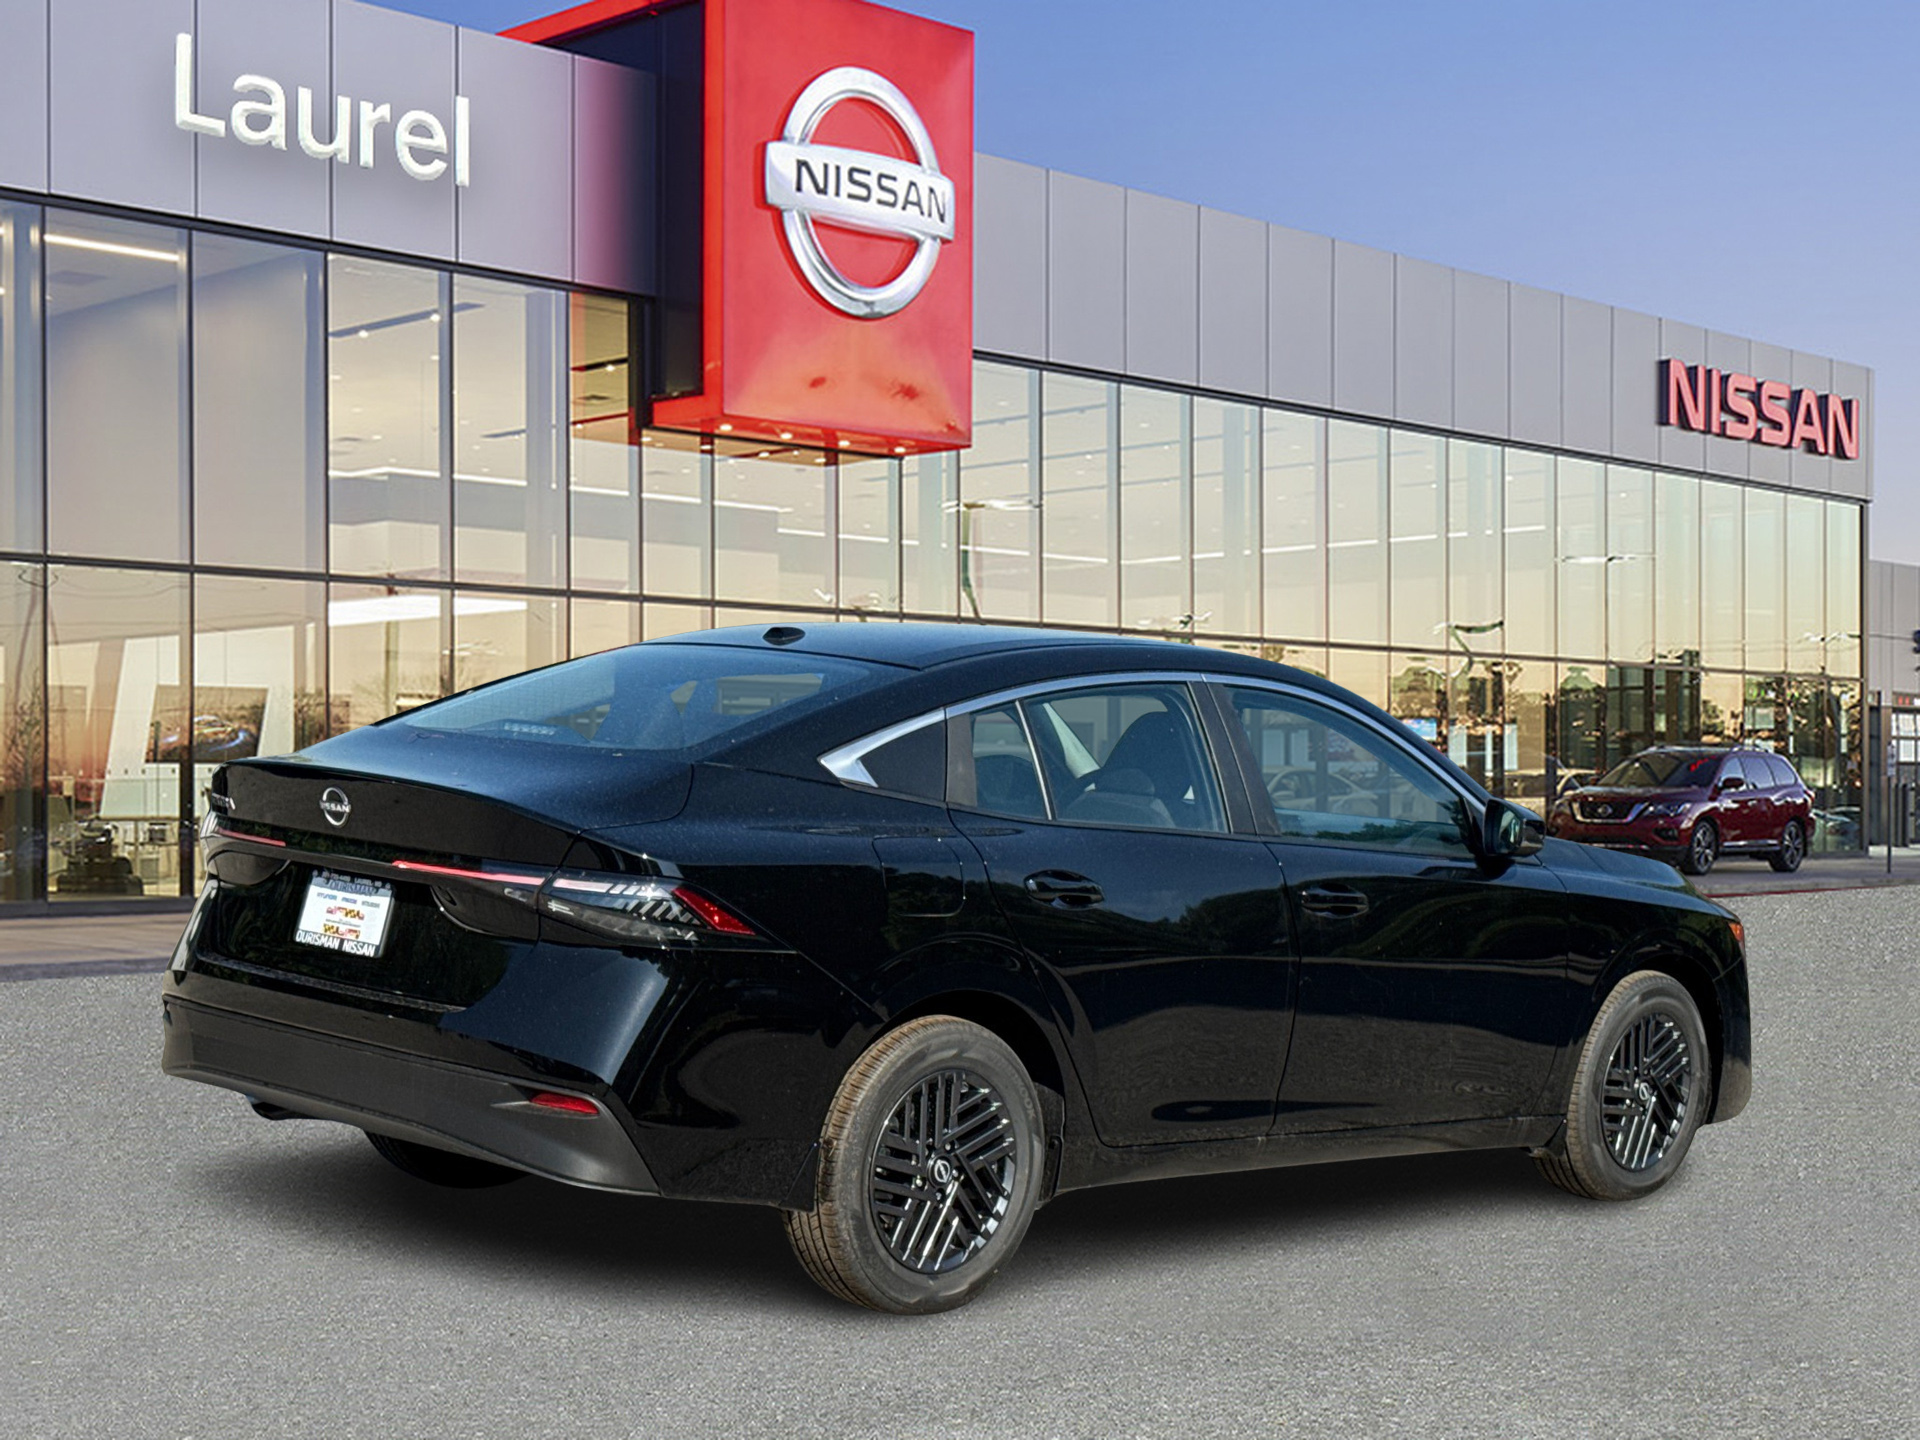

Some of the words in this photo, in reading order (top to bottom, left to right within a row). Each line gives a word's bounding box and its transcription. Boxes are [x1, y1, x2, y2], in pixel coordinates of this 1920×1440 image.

[175, 33, 470, 187] Laurel
[795, 158, 946, 224] NISSAN
[1656, 357, 1860, 460] NISSAN
[296, 929, 340, 950] OURISMAN
[342, 939, 376, 957] NISSAN
